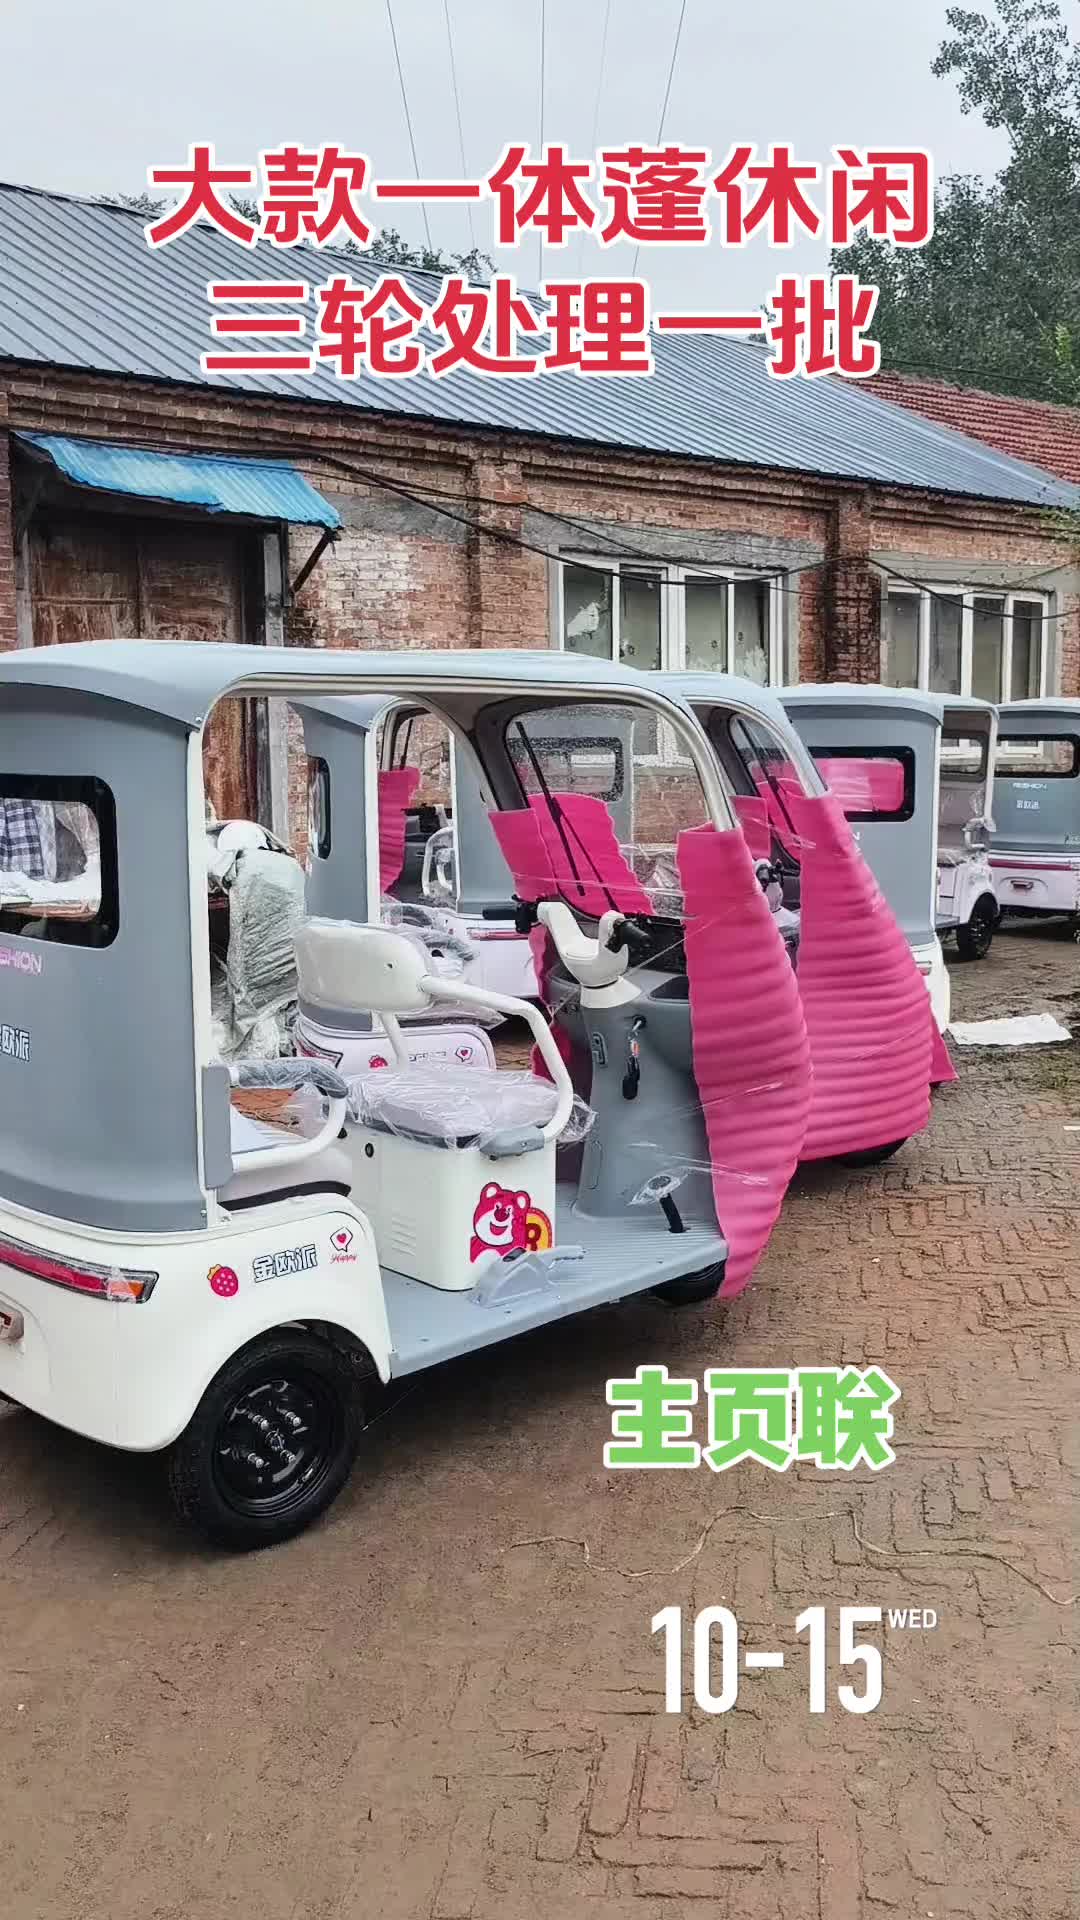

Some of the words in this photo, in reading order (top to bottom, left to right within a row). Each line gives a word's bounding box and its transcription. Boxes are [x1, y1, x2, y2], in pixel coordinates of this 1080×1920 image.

[0, 1023, 30, 1062] 欧派
[252, 1243, 318, 1283] 金欧派
